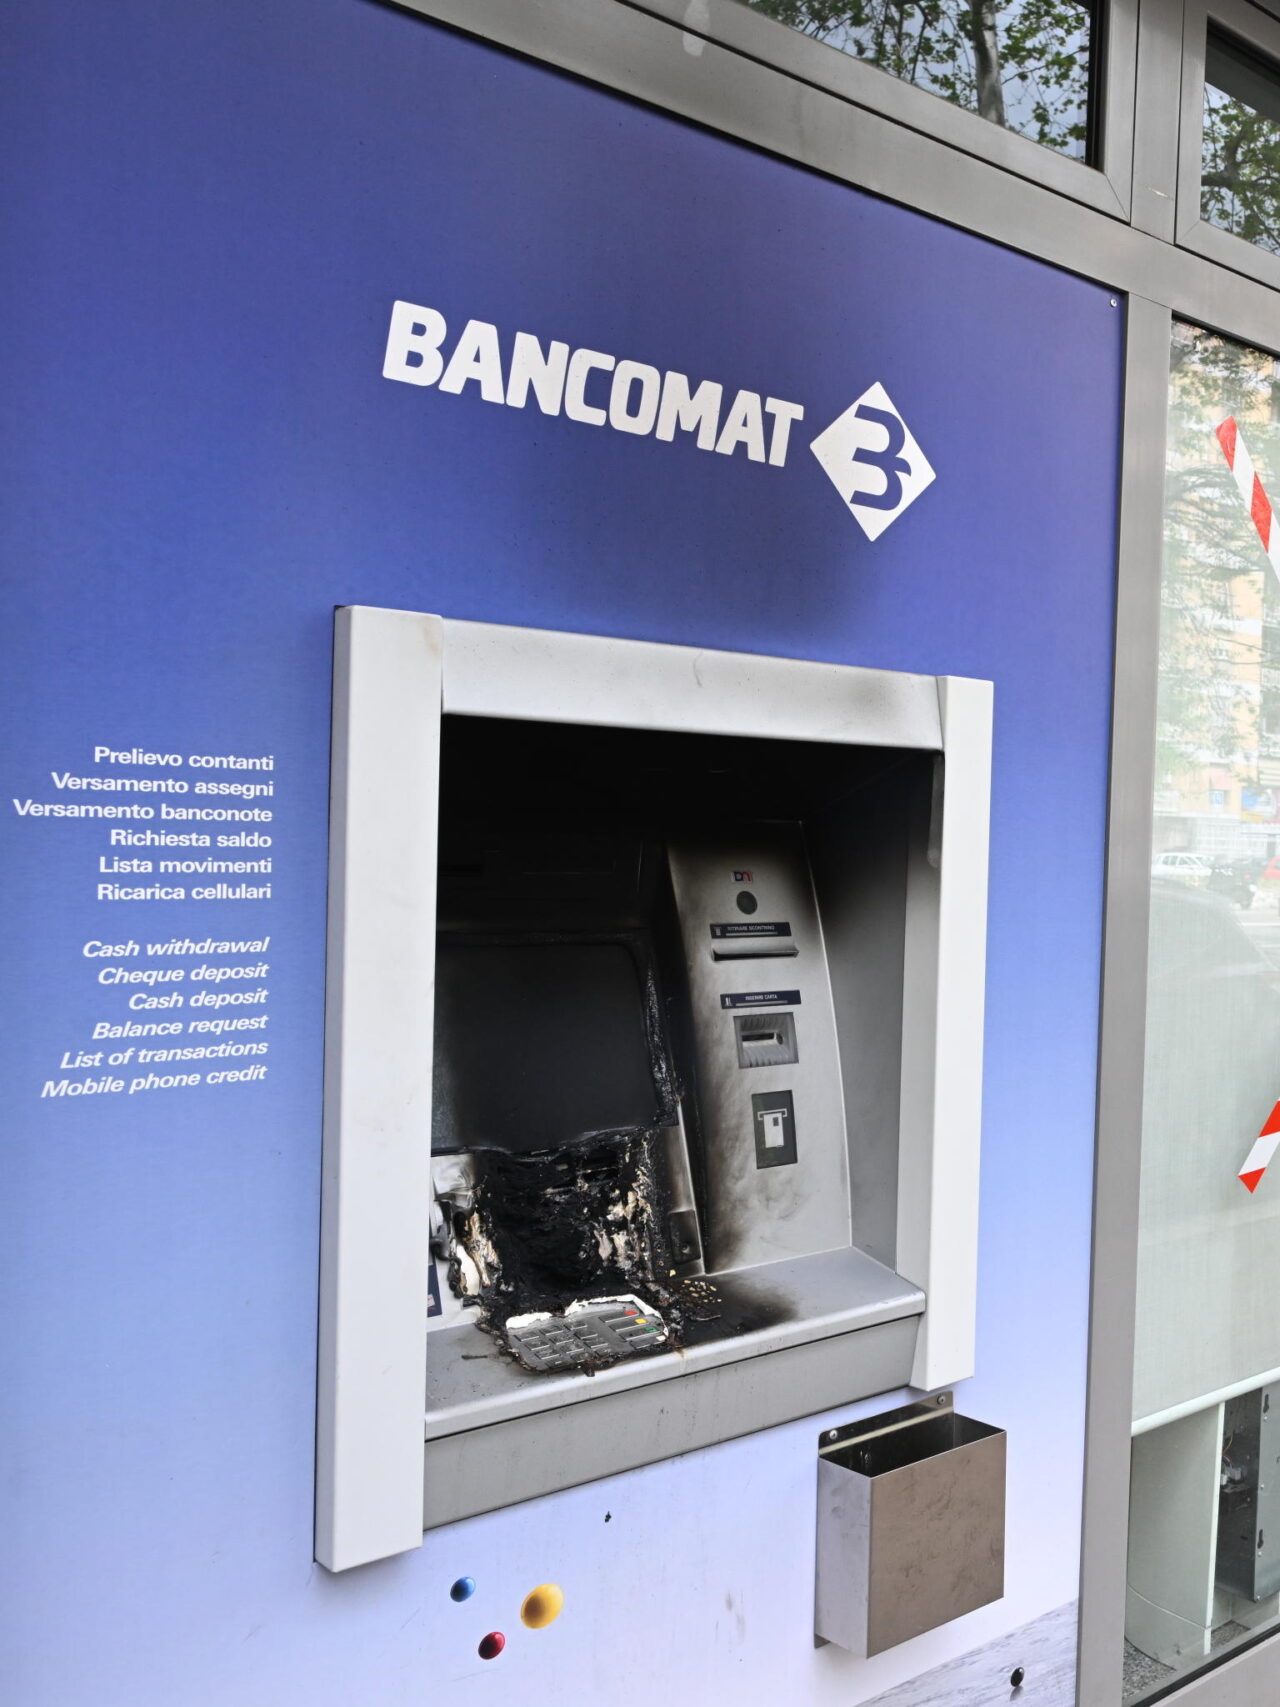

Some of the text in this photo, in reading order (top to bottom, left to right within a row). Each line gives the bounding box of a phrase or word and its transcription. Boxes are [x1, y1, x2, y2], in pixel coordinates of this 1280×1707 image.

[382, 300, 804, 467] BANCOMAT
[94, 746, 274, 770] Prelievo contanti
[51, 772, 274, 799] Versamento assegni
[13, 799, 272, 821] Versamento banconote
[110, 829, 272, 847] Richiesta saldo
[100, 856, 272, 873] Lista movimenti
[98, 883, 271, 900] Ricarica cellulari
[82, 936, 270, 958] Cash withdrawal
[98, 962, 270, 986] Cheque deposit
[129, 988, 269, 1010] Cash deposit
[92, 1014, 268, 1039] Balance request
[60, 1041, 268, 1069] List of transactions
[41, 1065, 268, 1098] Mobile phone credit
